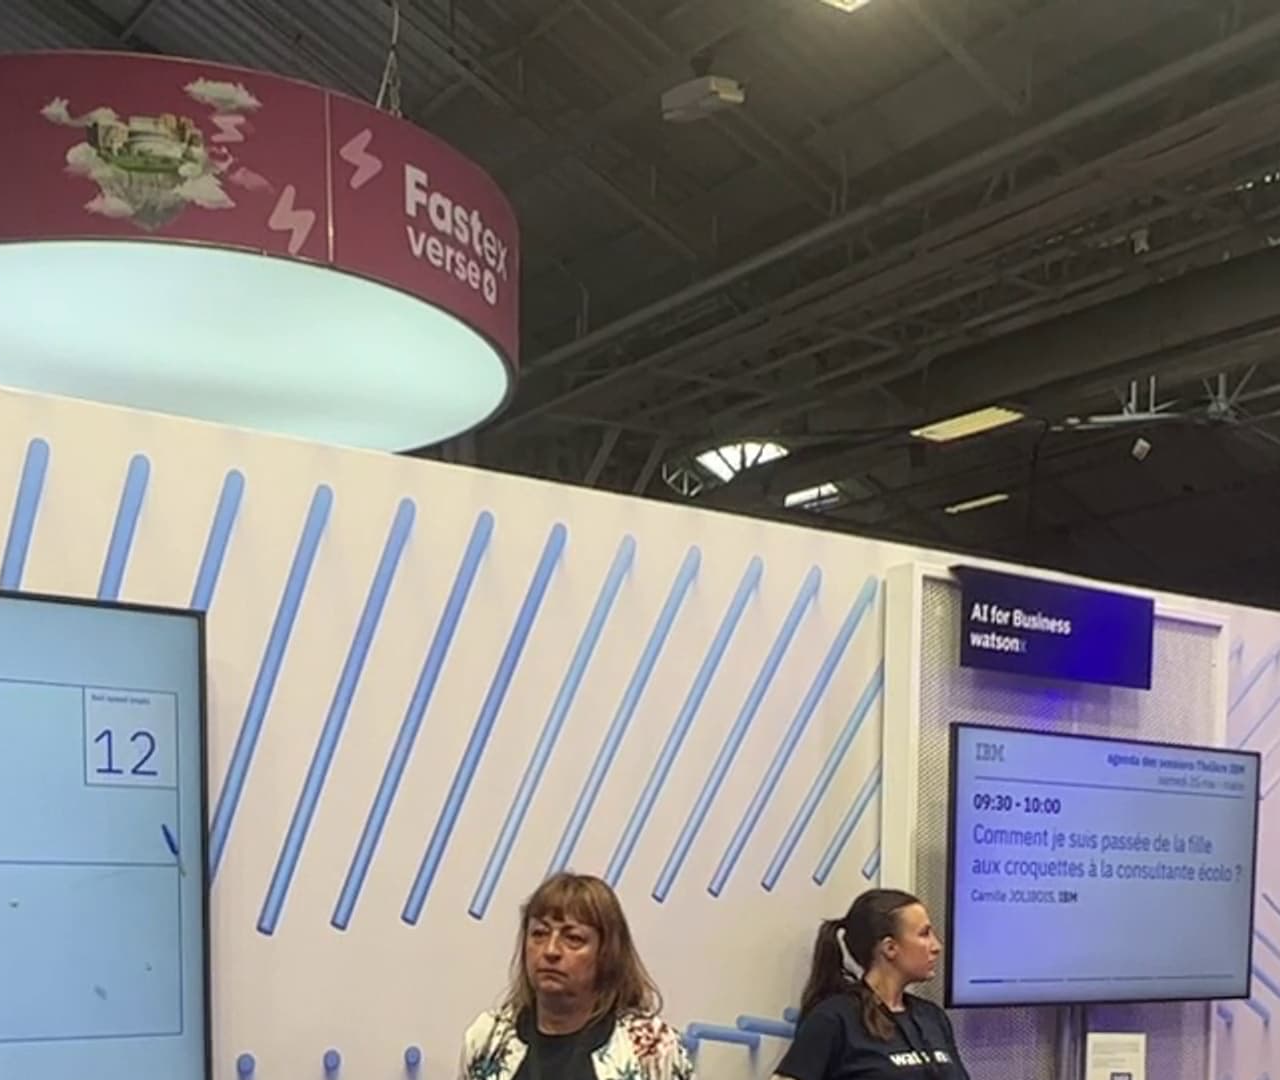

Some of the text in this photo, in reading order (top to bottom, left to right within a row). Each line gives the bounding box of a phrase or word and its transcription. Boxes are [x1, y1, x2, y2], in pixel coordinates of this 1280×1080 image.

[405, 163, 508, 281] Fastex
[971, 603, 1071, 635] AI for Business
[94, 729, 158, 776] 12
[976, 742, 1005, 762] IBM
[973, 793, 1012, 811] 09:30
[1024, 796, 1061, 814] 10:00
[973, 823, 1048, 847] Comment
[1050, 827, 1065, 852] je
[1068, 830, 1098, 849] suis
[1101, 832, 1151, 853] passée
[1153, 834, 1171, 853] de
[1174, 834, 1186, 853] la
[972, 859, 1001, 875] aux
[1004, 859, 1085, 880] croquettes
[1101, 858, 1113, 878] la
[1116, 860, 1196, 880] consultante
